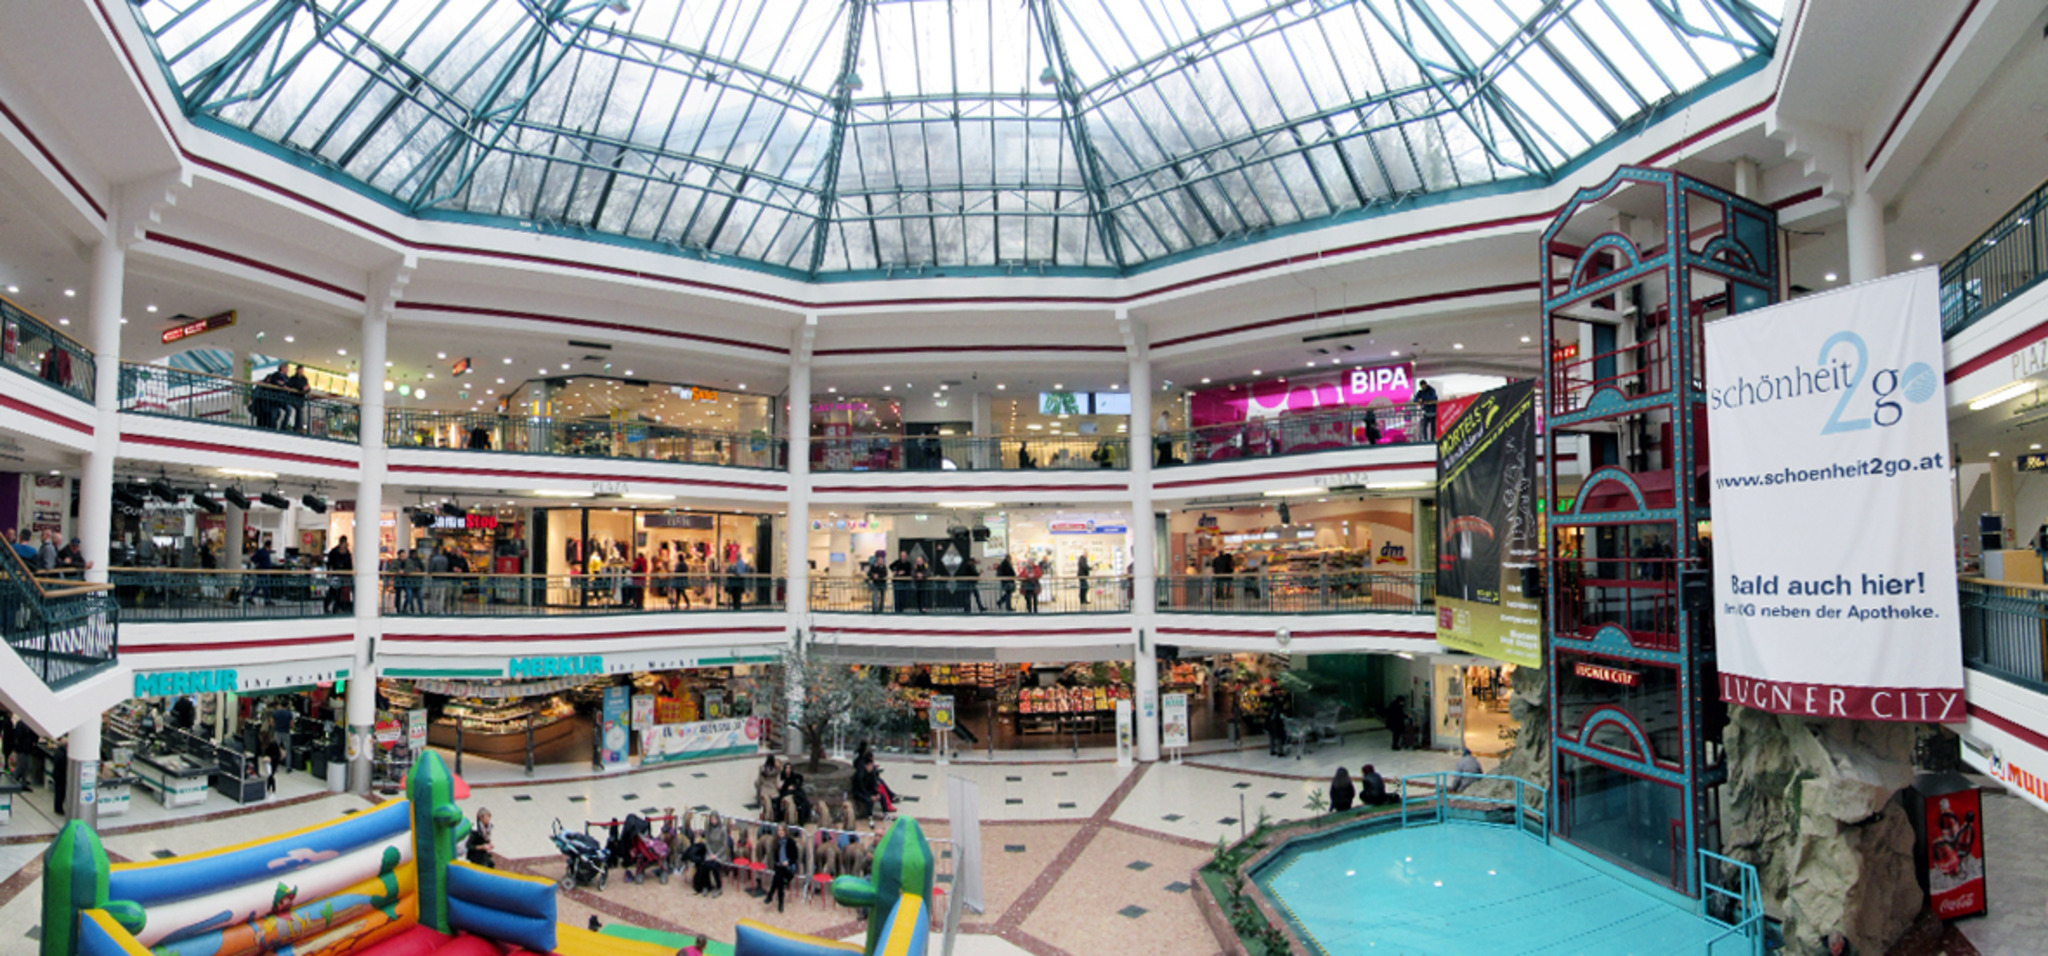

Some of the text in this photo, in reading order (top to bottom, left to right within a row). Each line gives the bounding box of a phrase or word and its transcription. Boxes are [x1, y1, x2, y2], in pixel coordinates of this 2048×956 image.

[1351, 366, 1410, 394] BIPA
[1198, 512, 1218, 527] dm
[1381, 541, 1404, 557] dm
[1731, 571, 1926, 596] Bald auch hier!
[1761, 604, 1811, 618] neben
[1815, 605, 1843, 619] der
[1848, 605, 1940, 622] Apotheke.
[509, 654, 605, 678] MERKUR
[134, 669, 238, 698] MERKUR
[1723, 675, 1958, 721] LUGNER CITY
